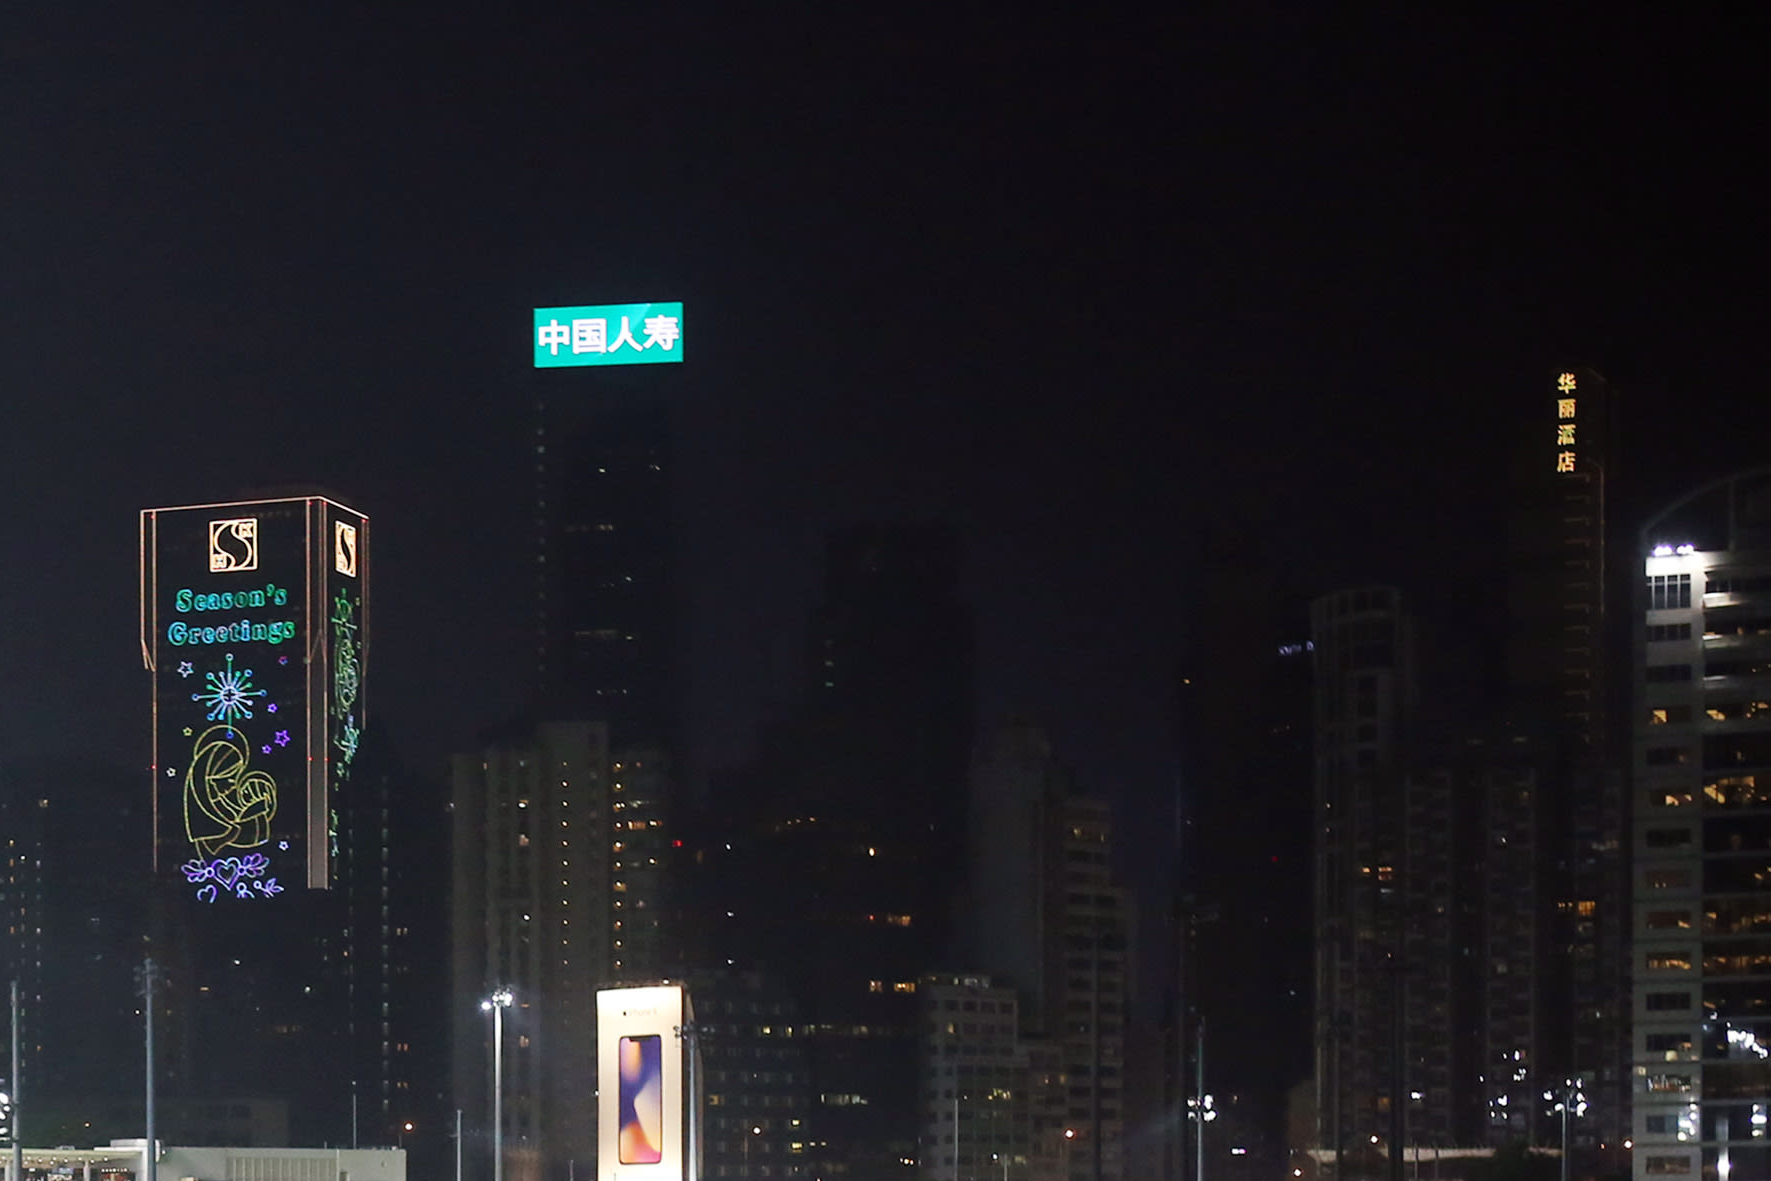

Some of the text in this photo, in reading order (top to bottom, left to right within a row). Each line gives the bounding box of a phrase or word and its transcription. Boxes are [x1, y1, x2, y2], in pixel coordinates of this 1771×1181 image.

[538, 314, 680, 356] 中国人寿
[175, 583, 288, 613] Season's
[167, 618, 296, 646] Greetings
